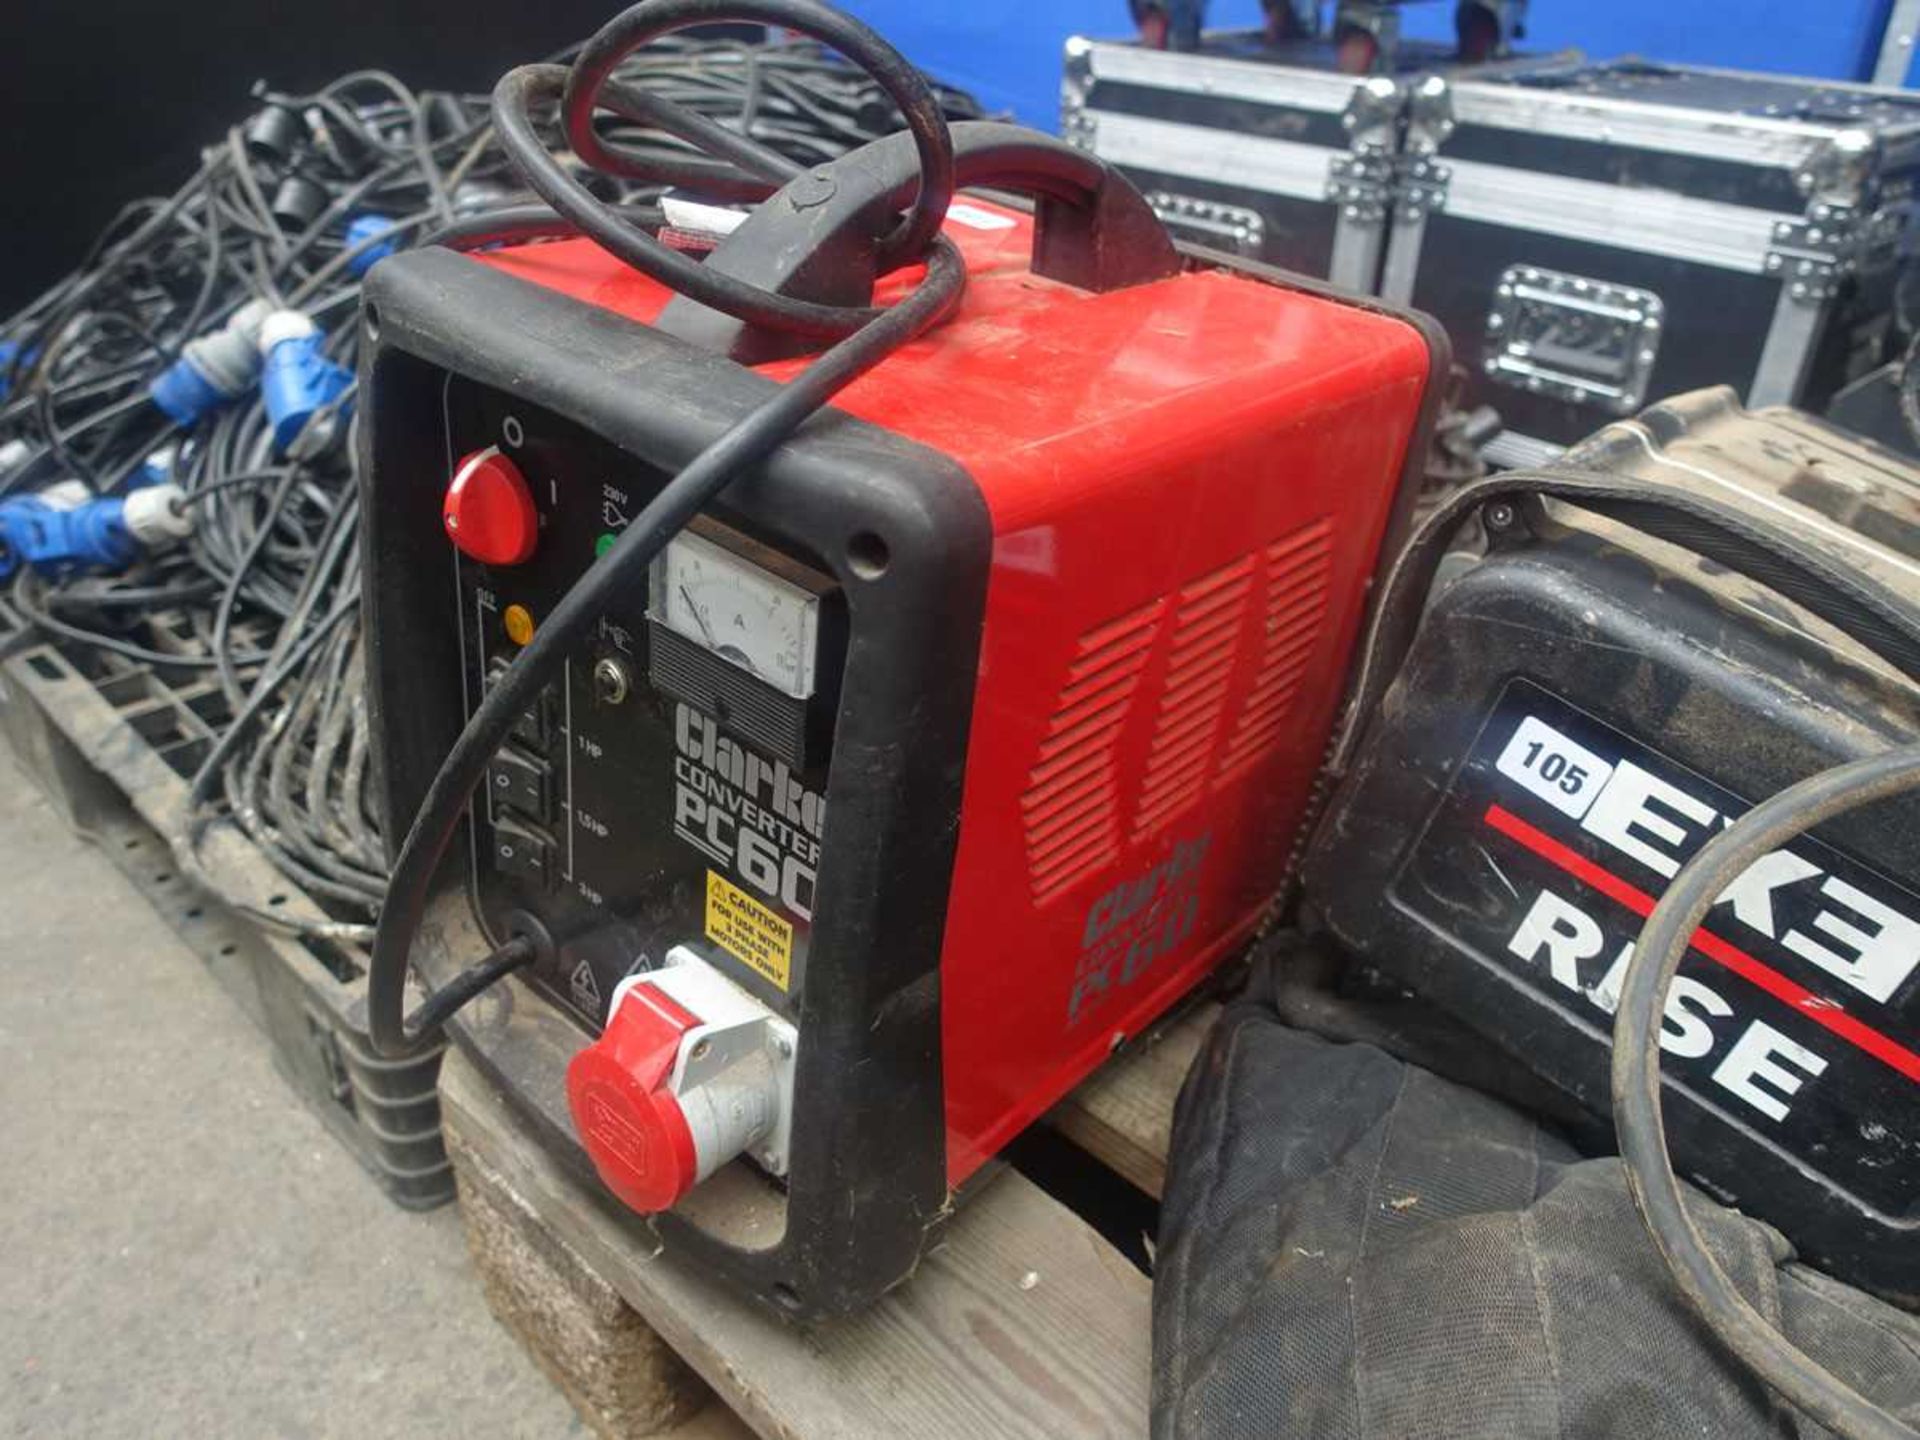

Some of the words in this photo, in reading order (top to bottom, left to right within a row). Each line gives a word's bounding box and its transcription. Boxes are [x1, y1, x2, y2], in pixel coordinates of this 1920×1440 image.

[676, 702, 827, 840] Clarke
[1521, 740, 1589, 796] 105
[676, 756, 821, 864] CONVERTER
[712, 900, 732, 919] FOR
[735, 915, 755, 934] USE
[758, 930, 785, 956] WITH
[729, 892, 788, 939] CAUTION
[735, 928, 769, 958] PHASE
[711, 925, 753, 961] MOTORS
[756, 957, 783, 981] ONLY
